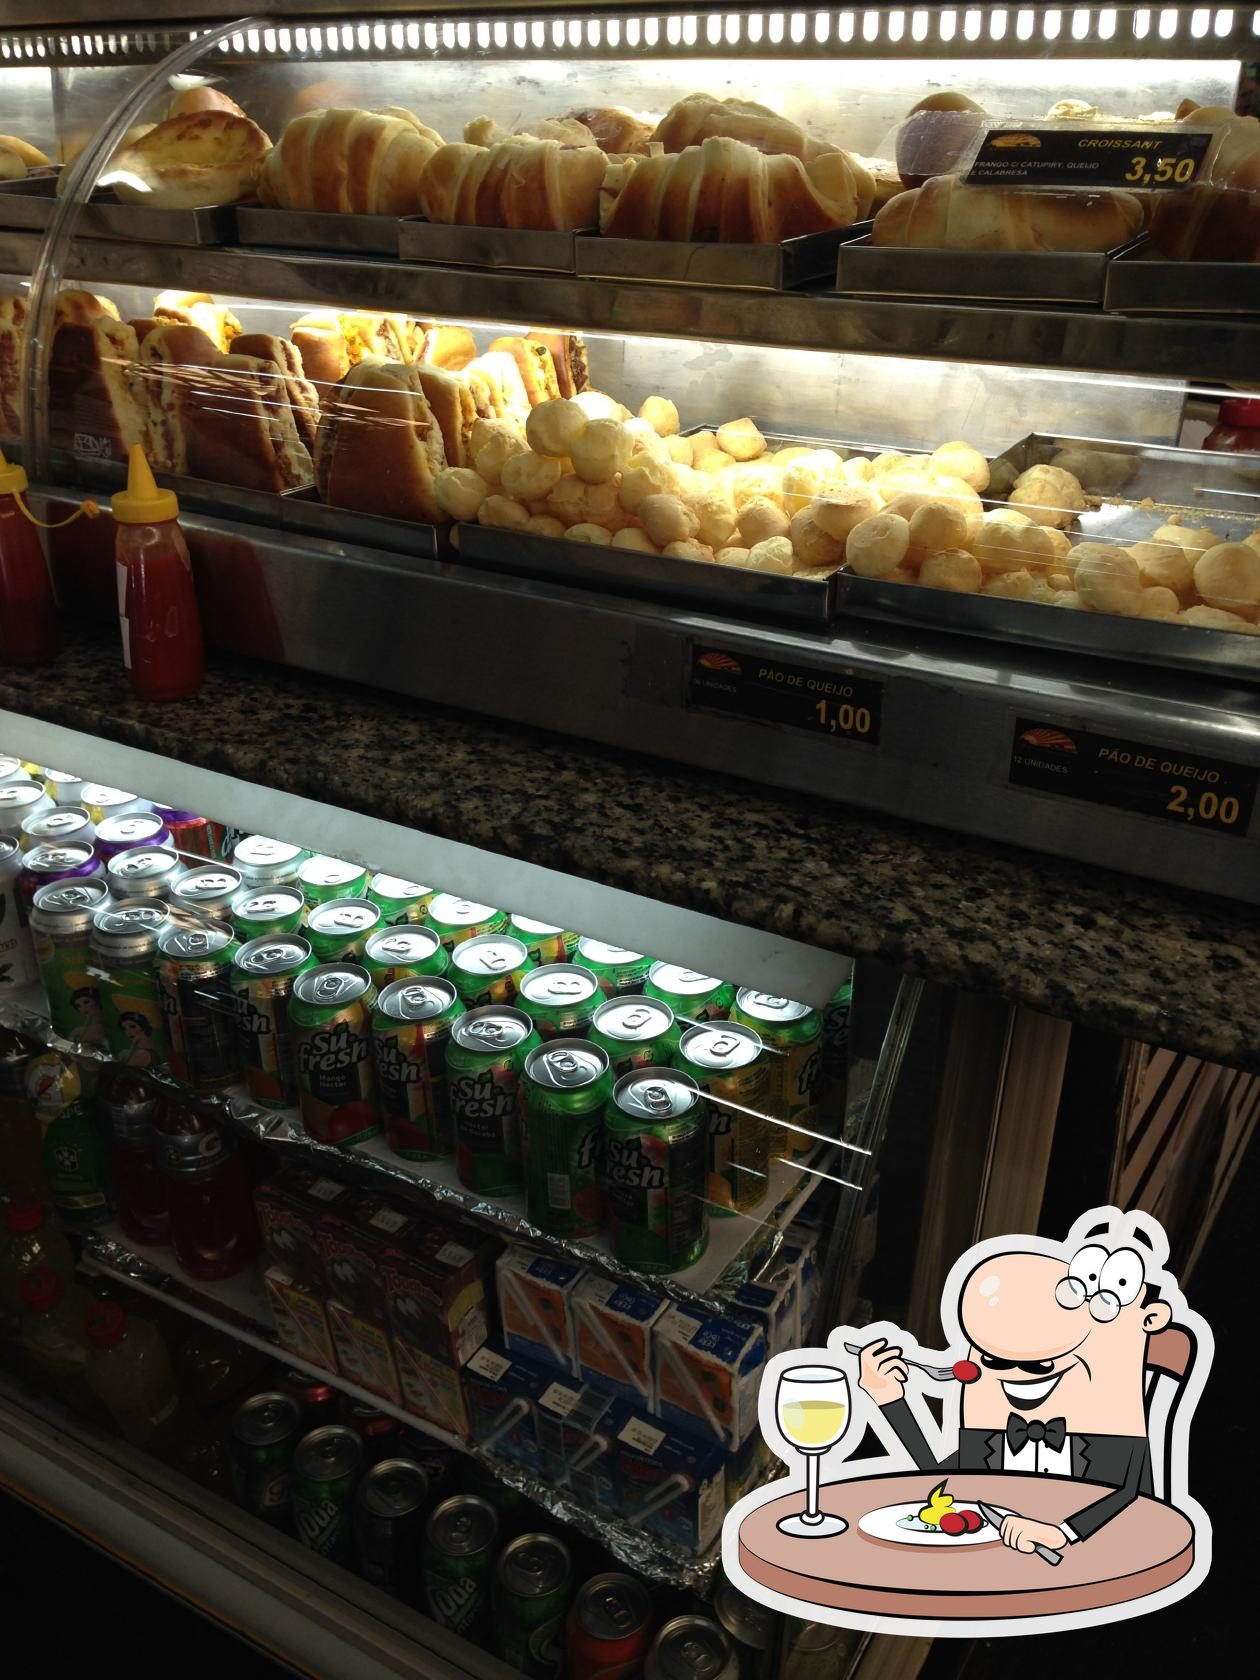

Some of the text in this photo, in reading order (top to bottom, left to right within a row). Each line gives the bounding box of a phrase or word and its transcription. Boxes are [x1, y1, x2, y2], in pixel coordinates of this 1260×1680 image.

[1077, 138, 1163, 151] CROISSANT
[1123, 155, 1197, 186] 3,50
[785, 674, 804, 687] DE
[806, 678, 854, 697] QUEIJO
[815, 699, 872, 735] 1,00
[1024, 758, 1070, 775] UNIDADES
[1134, 756, 1156, 771] DE
[1159, 761, 1220, 784] QUEIJO
[1166, 784, 1241, 825] 2,00
[298, 1037, 368, 1073] fresh
